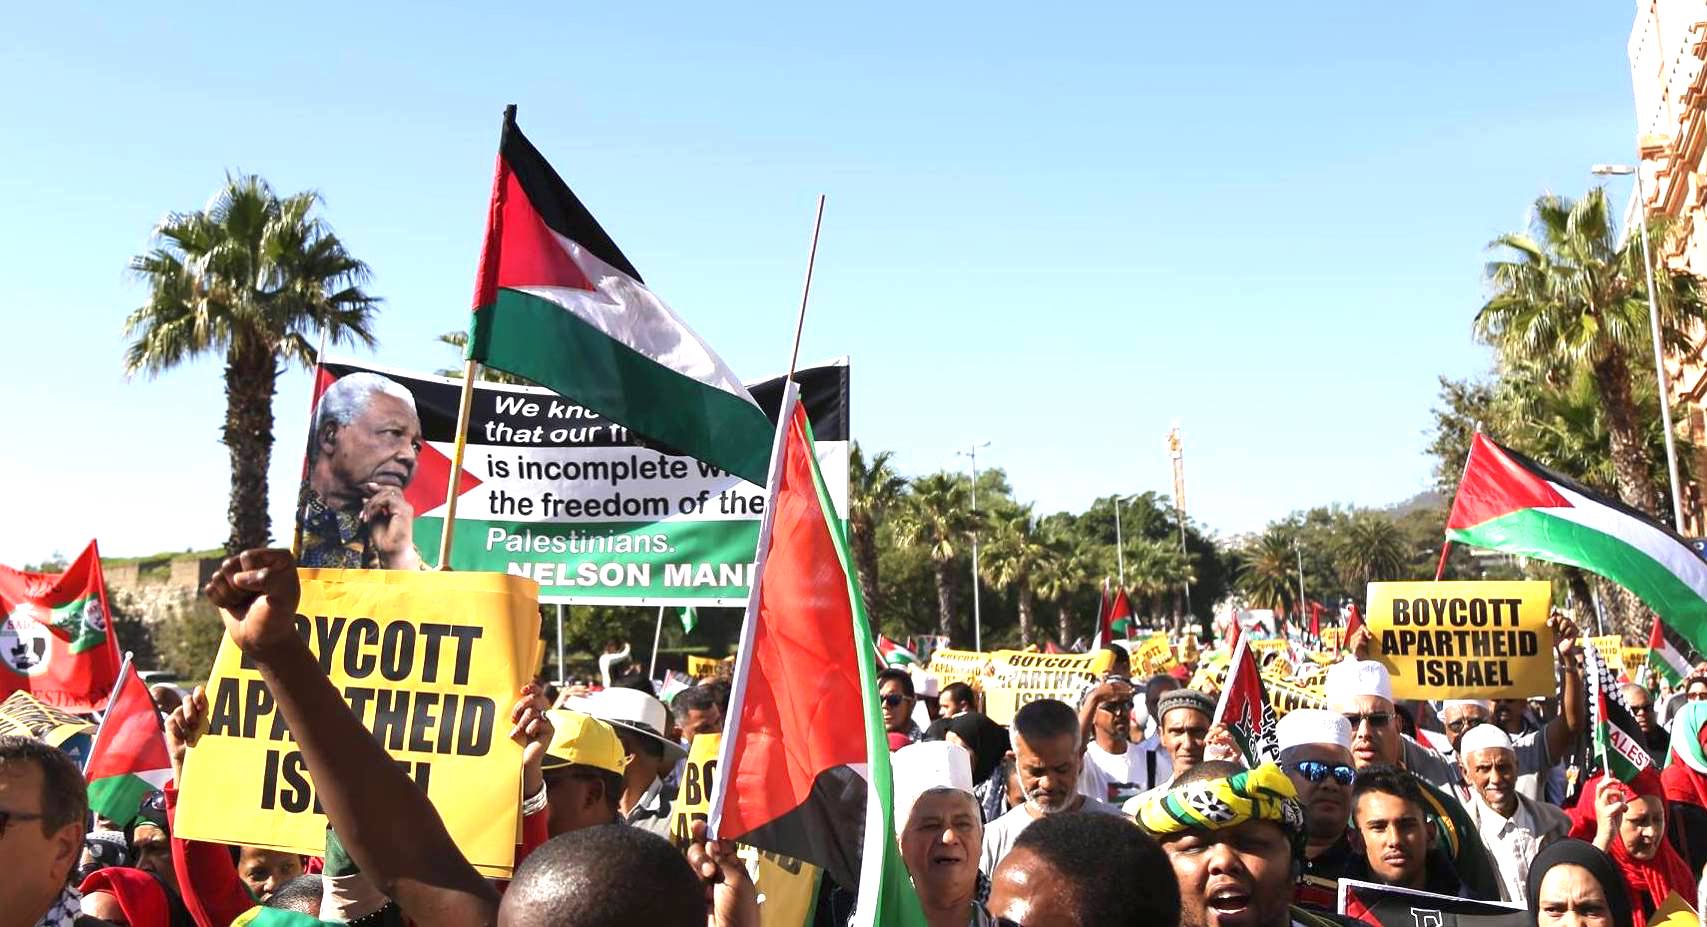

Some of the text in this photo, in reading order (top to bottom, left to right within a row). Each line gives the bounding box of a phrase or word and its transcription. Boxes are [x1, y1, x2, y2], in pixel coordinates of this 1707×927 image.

[494, 395, 540, 417] We
[485, 420, 544, 443] that
[550, 425, 602, 443] our
[487, 454, 730, 486] is incomplete w
[489, 490, 765, 518] the freedom of the
[486, 527, 676, 553] Palestinians.
[507, 561, 651, 587] NELSON
[1392, 598, 1522, 627] BOYCOTT
[240, 613, 484, 686] YCOTT
[1382, 629, 1538, 657] APARTHEID
[1008, 654, 1094, 669] BOYCOTT
[1416, 660, 1513, 687] ISRAEL
[209, 677, 496, 757] APTHEID
